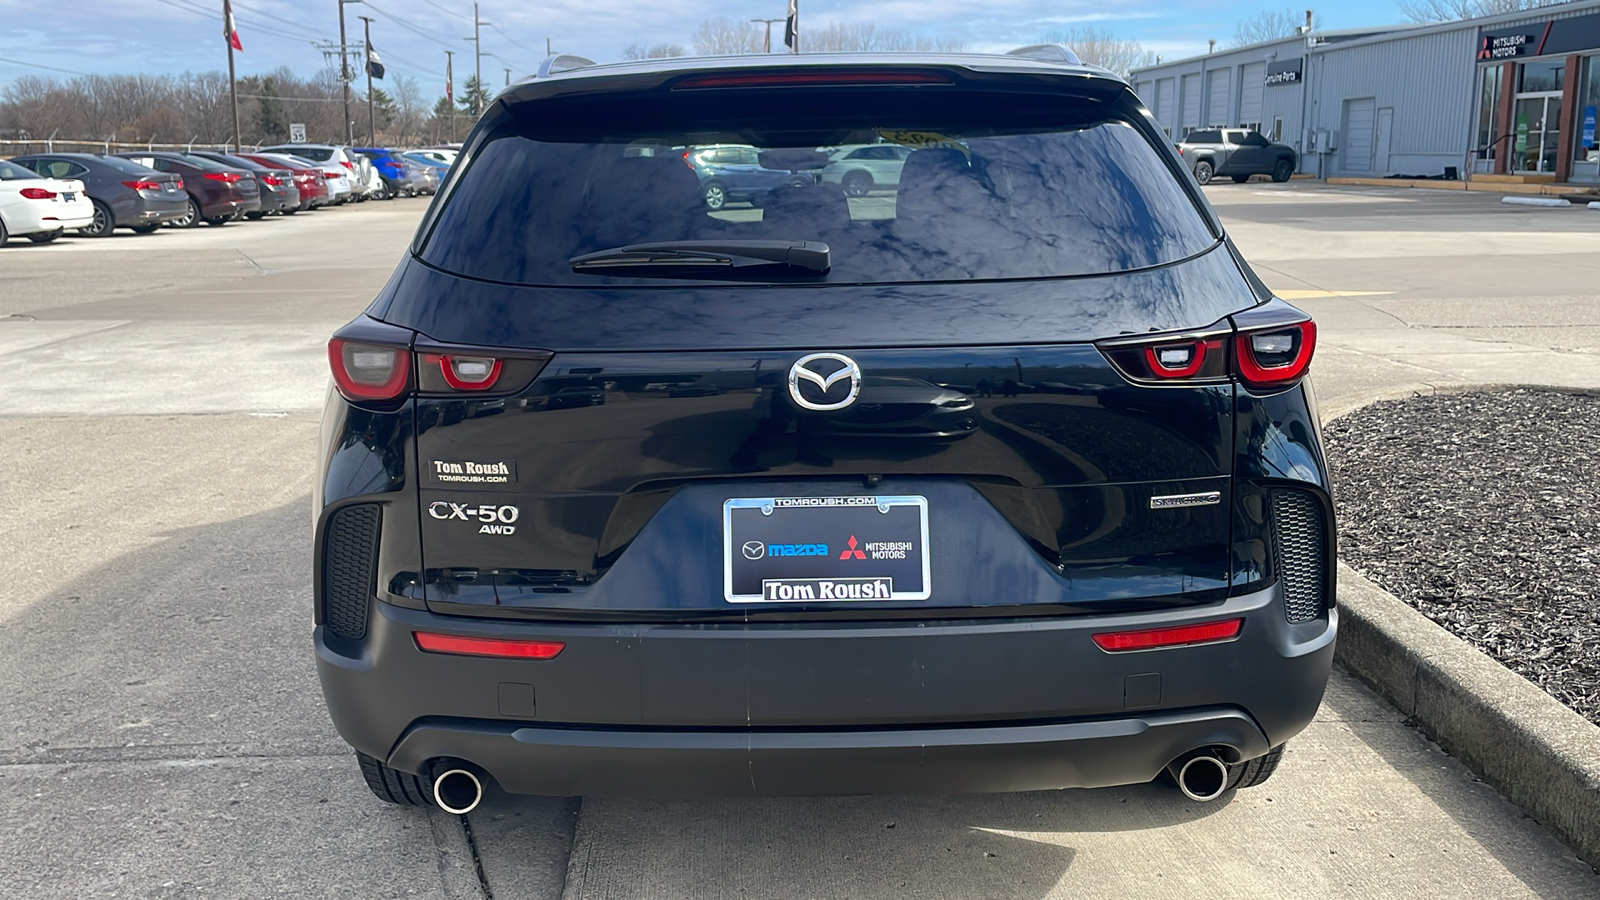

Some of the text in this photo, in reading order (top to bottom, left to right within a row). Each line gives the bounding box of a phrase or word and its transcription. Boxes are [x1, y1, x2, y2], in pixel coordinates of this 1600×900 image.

[1492, 35, 1526, 48] MITSUBISHI
[1492, 46, 1517, 58] MOTORS
[1265, 71, 1295, 84] Genuine Parts
[292, 133, 304, 141] 35
[434, 460, 509, 475] Tom Roush
[438, 475, 507, 483] TOMROUSH.COM
[775, 497, 876, 507] TOMROUSH.COM
[428, 501, 519, 523] CX-50
[478, 525, 515, 535] AWD
[768, 543, 829, 557] mazda
[865, 542, 912, 552] MITSUBISHI
[872, 550, 906, 560] MOTORS
[765, 580, 890, 600] Tom Roush
